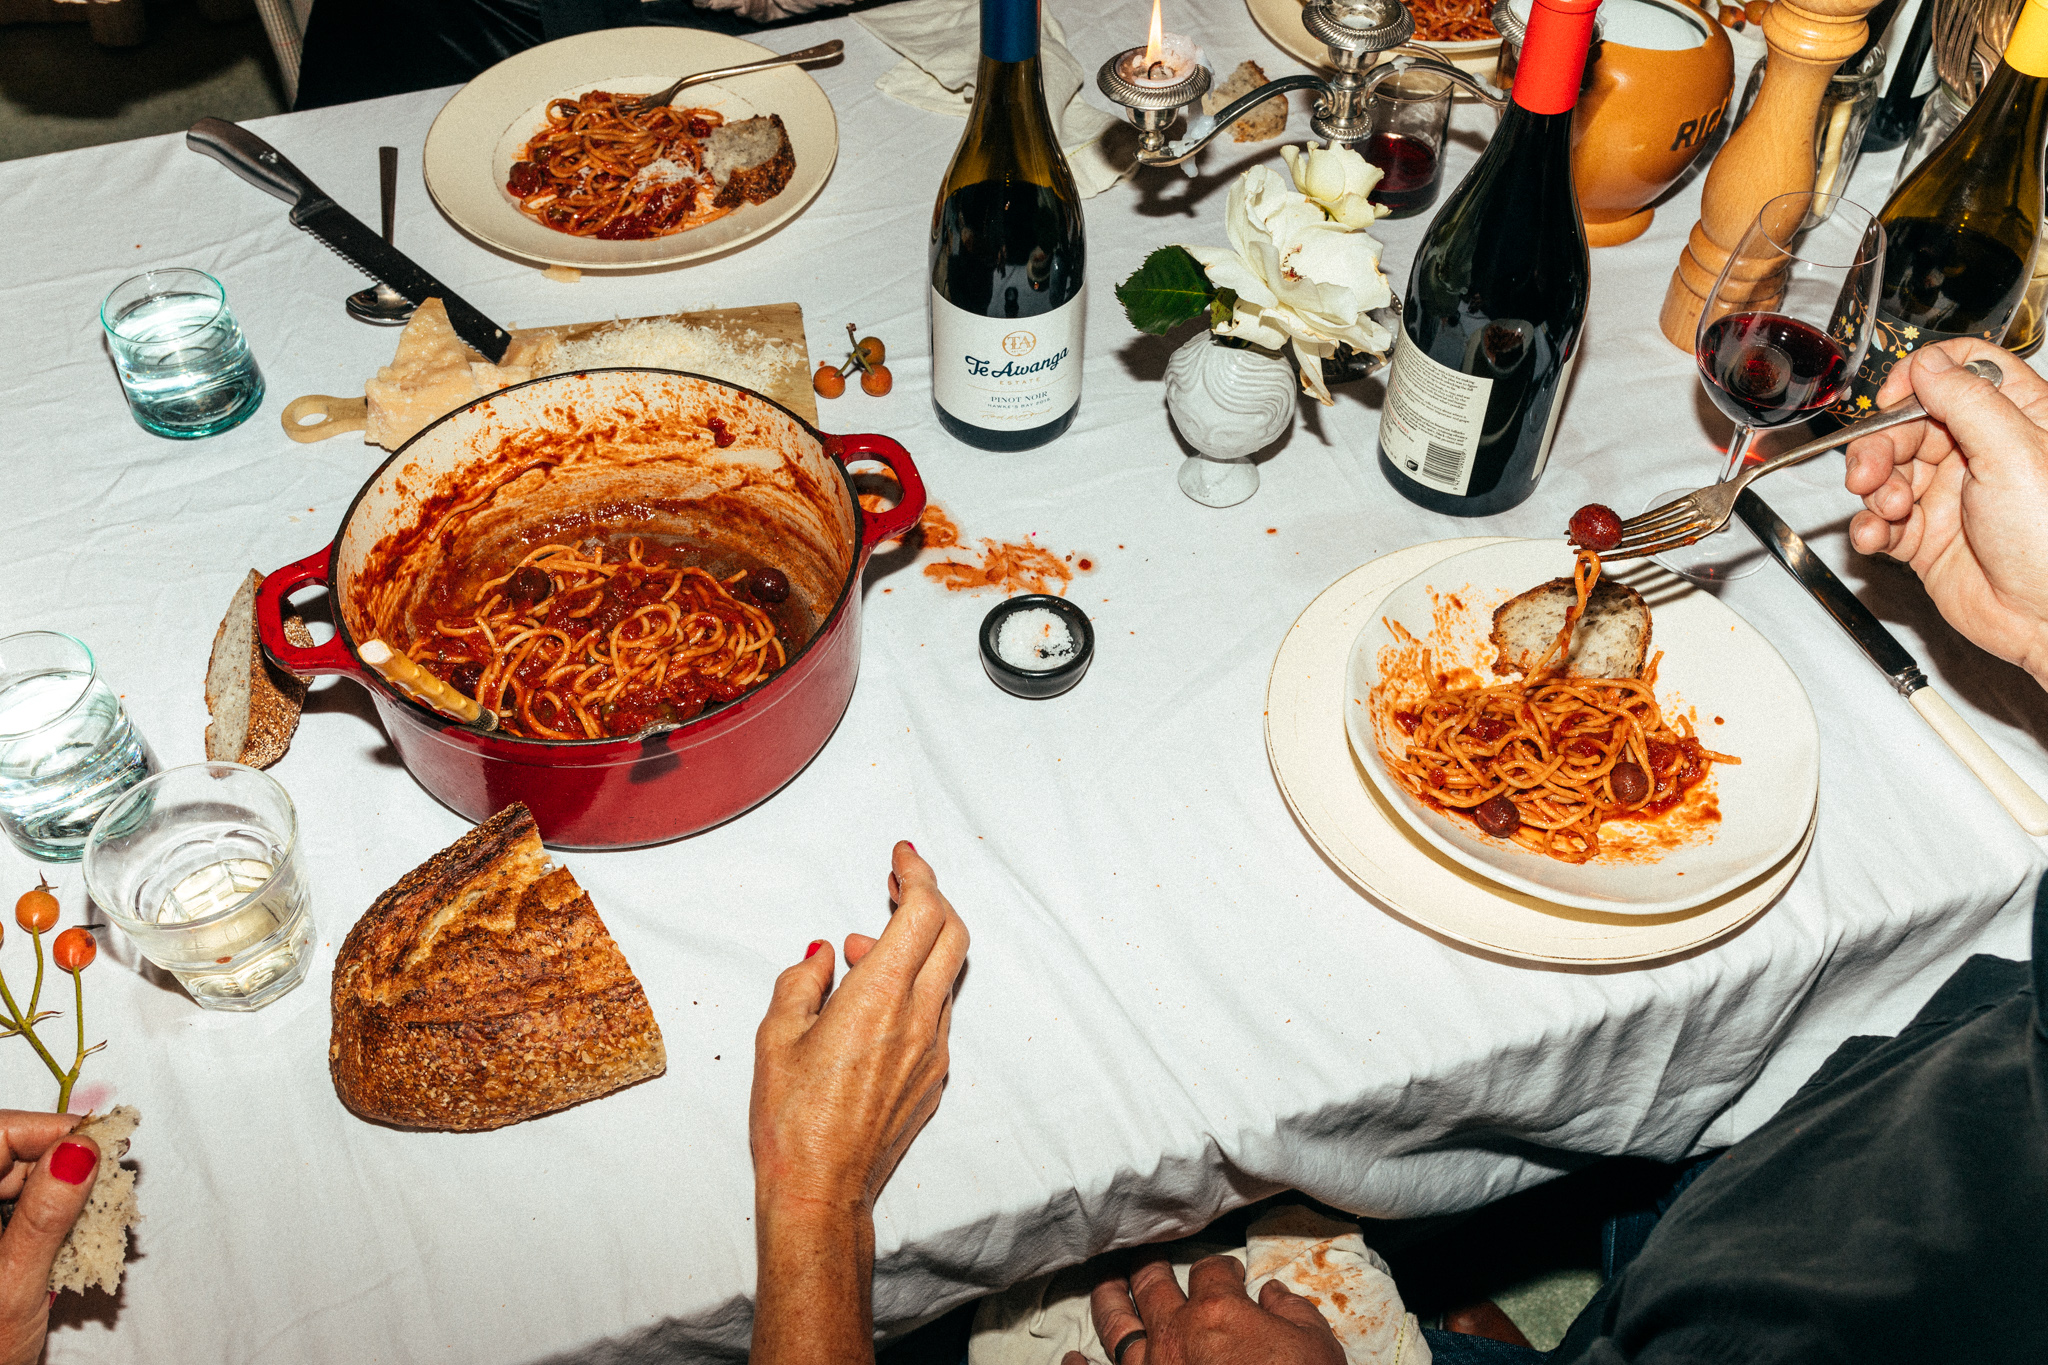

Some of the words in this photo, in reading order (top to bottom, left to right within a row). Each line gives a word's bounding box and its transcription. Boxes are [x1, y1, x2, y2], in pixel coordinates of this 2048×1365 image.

[1670, 101, 1728, 151] RIC
[1006, 335, 1032, 350] TA
[964, 355, 991, 377] Te
[991, 347, 1070, 378] Awanga
[999, 377, 1040, 385] ESTATE
[1025, 391, 1048, 401] NOIR
